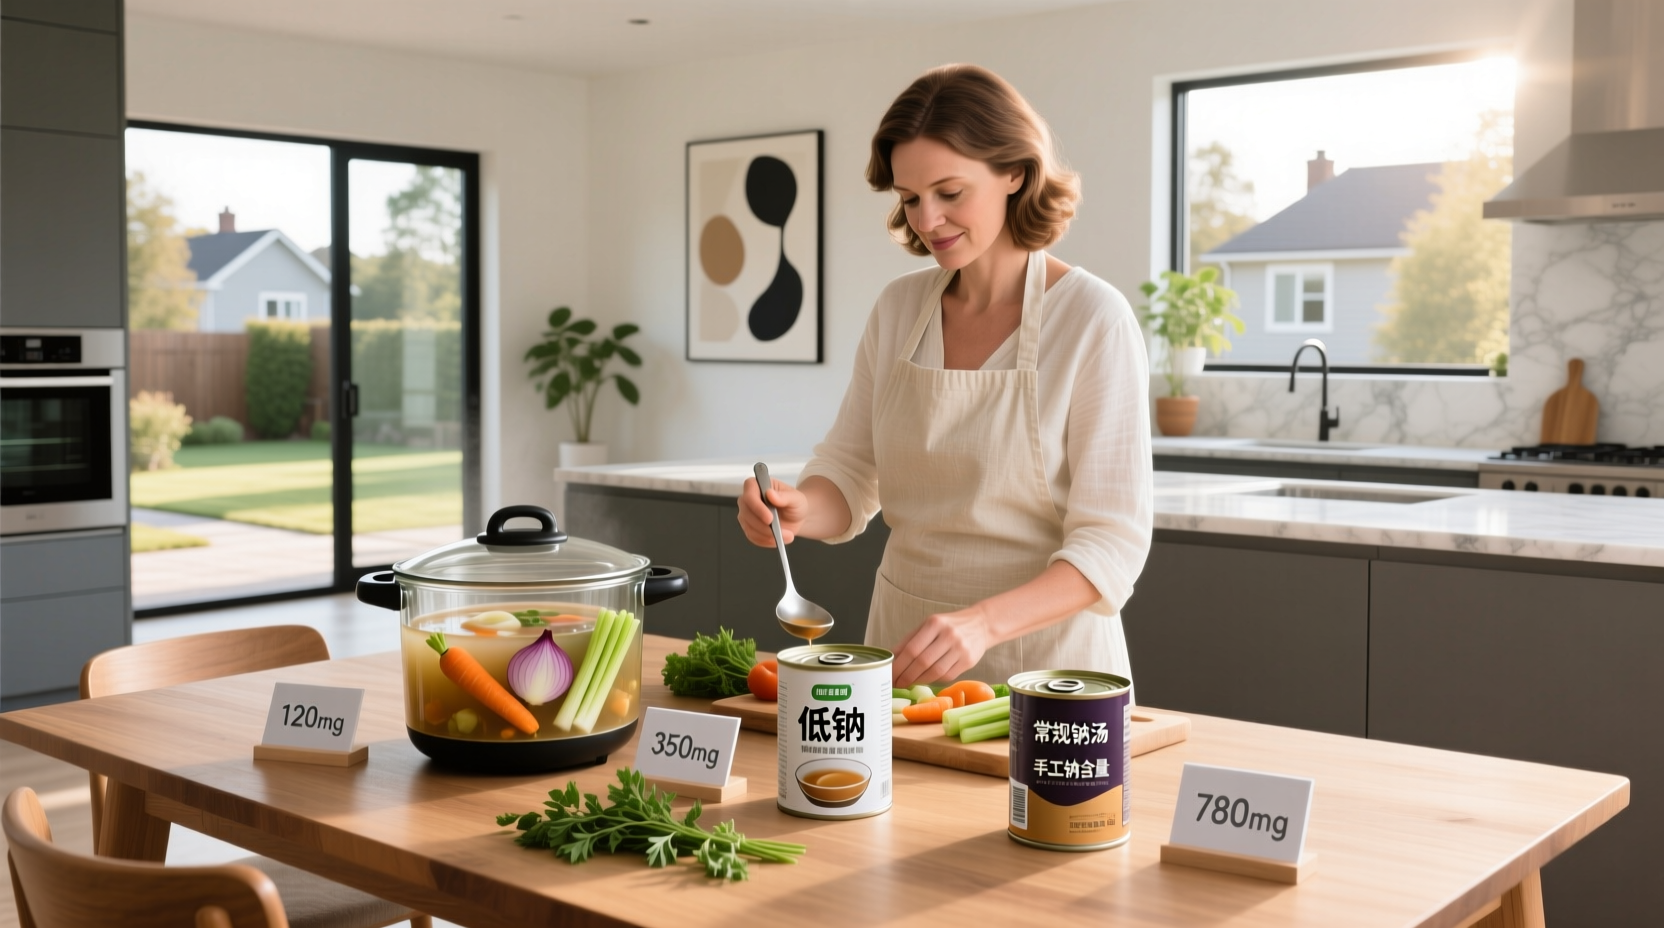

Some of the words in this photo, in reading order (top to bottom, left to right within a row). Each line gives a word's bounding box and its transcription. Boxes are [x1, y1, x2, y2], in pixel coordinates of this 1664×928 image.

[282, 704, 345, 737] 120mg
[797, 705, 865, 742] 低钠
[1033, 719, 1109, 746] 常规钠汤
[651, 731, 720, 770] 350mg
[1195, 792, 1289, 842] 780mg
